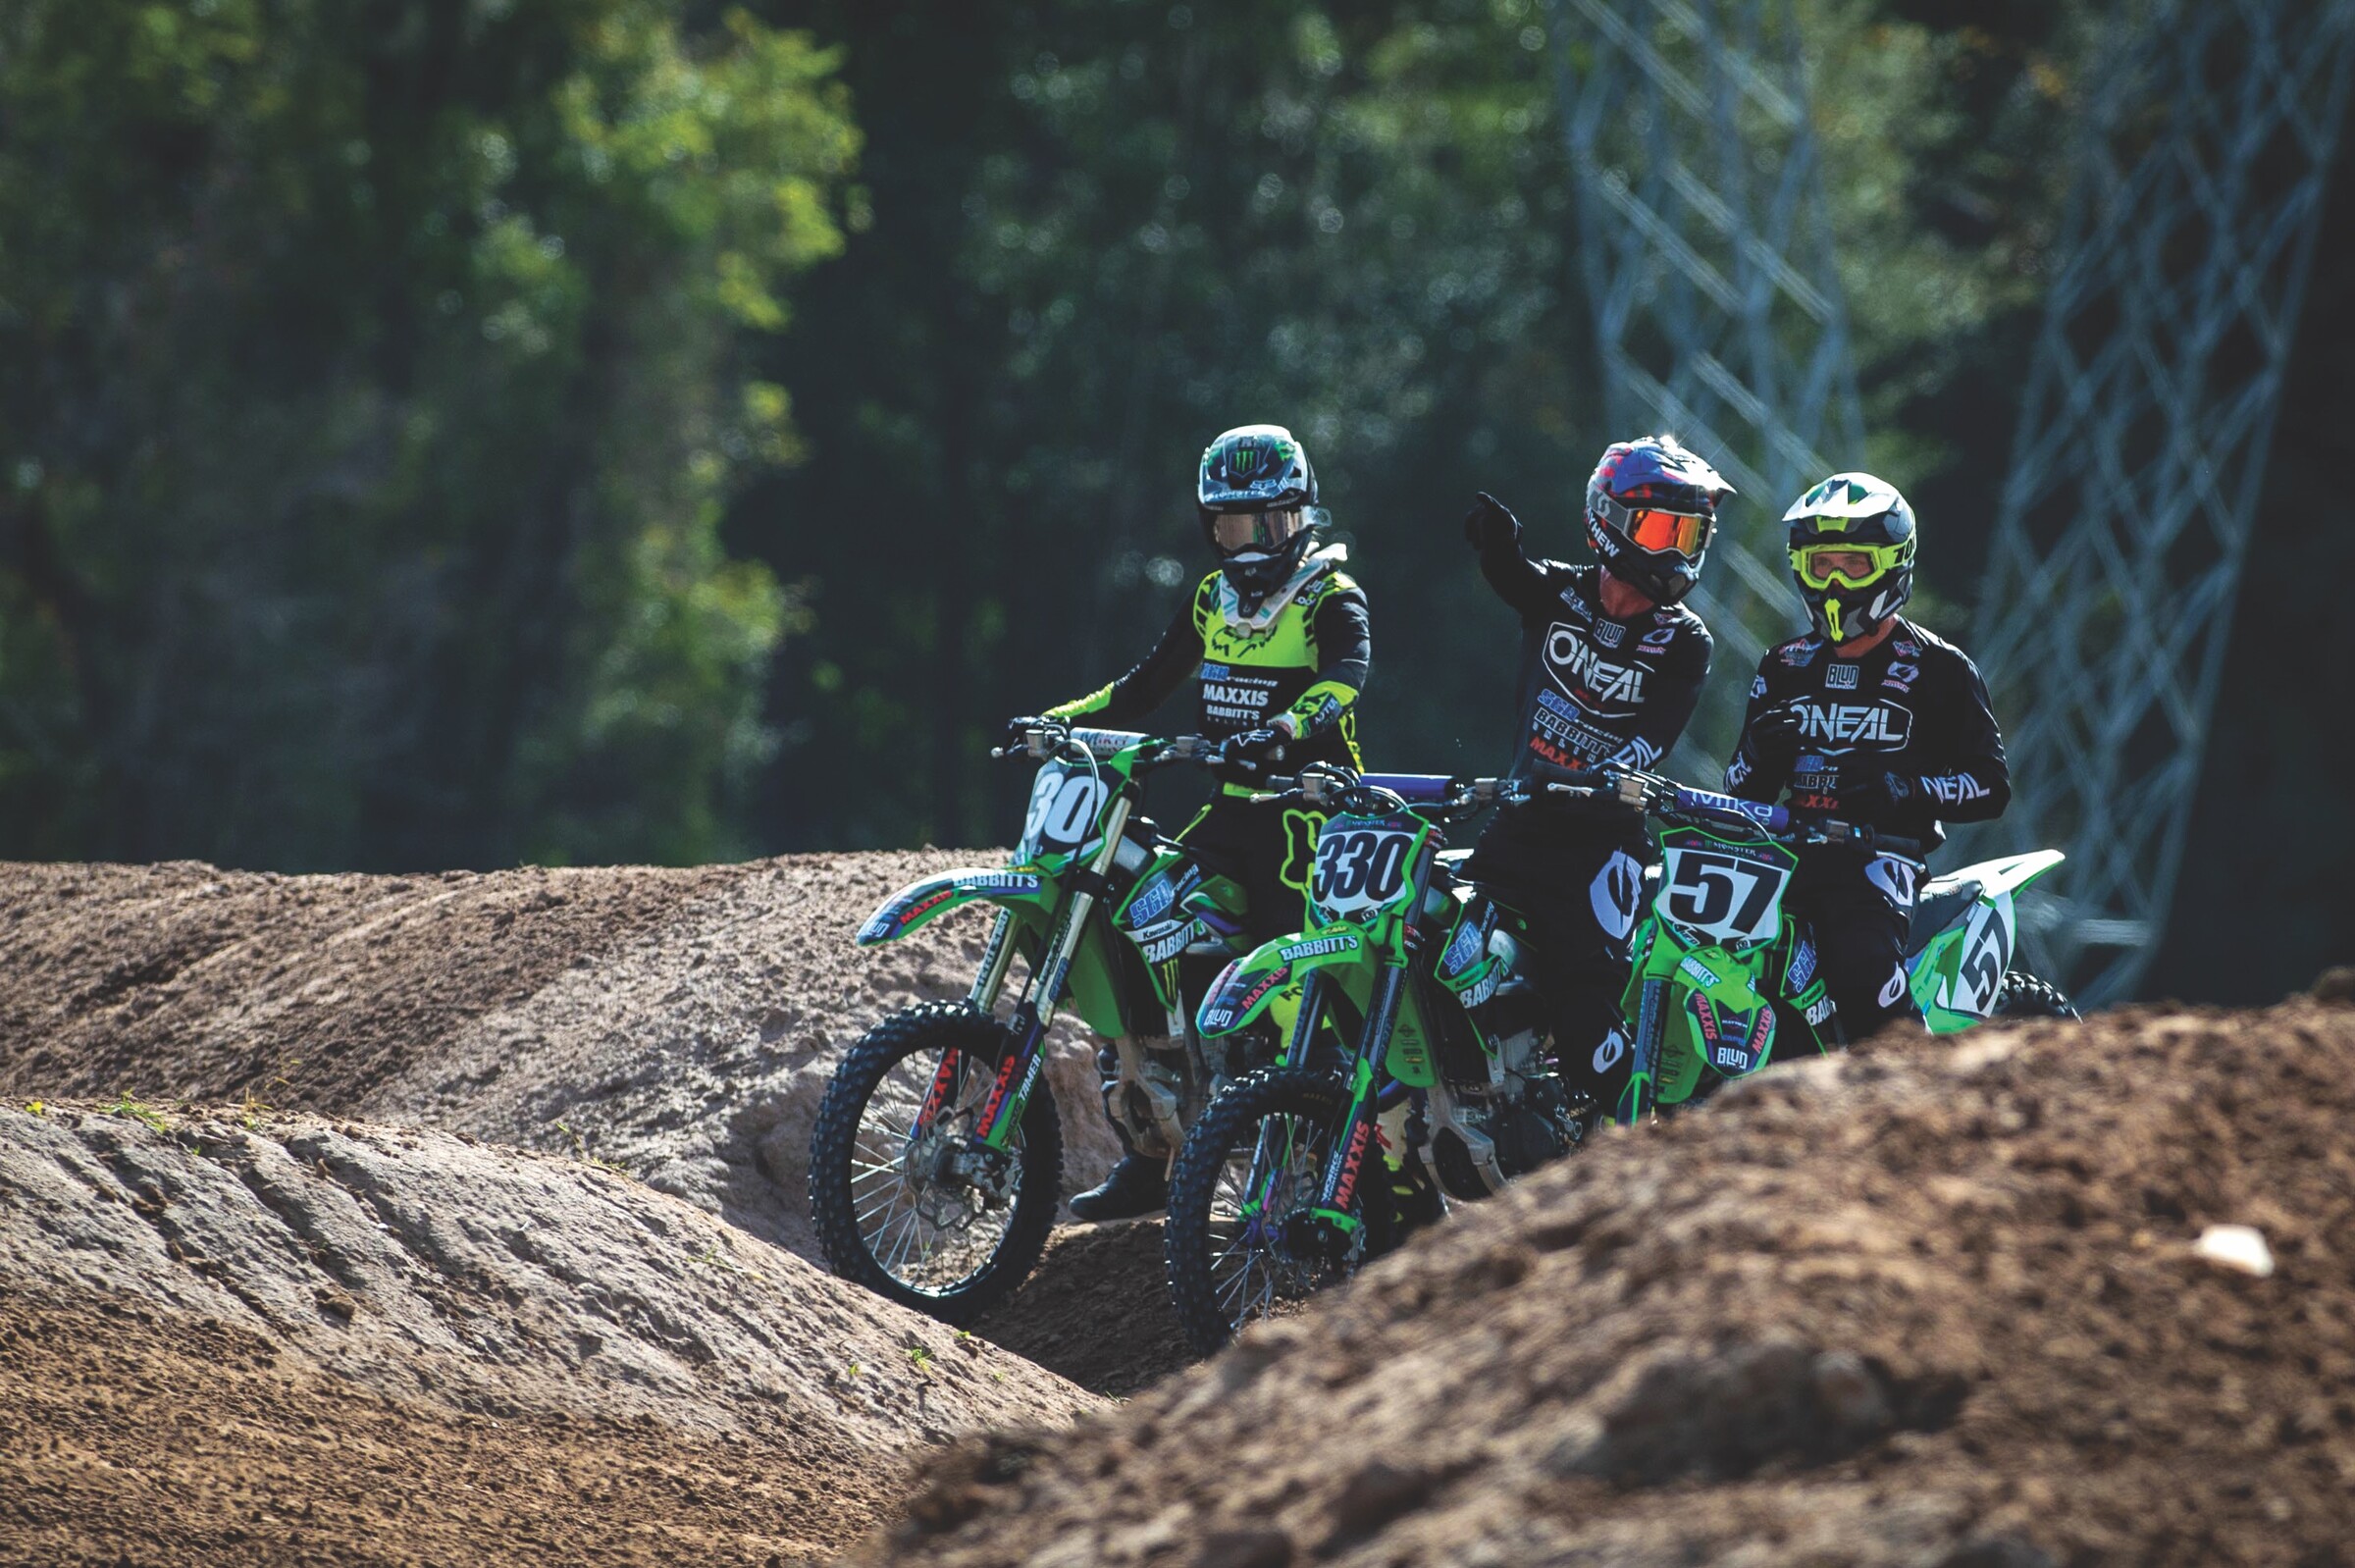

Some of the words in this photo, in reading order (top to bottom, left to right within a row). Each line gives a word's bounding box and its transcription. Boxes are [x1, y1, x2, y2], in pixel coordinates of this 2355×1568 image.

[1203, 684, 1269, 706] MAXXIS
[1827, 665, 1858, 687] BLUD
[1206, 705, 1260, 720] BABBITT'S
[1172, 863, 1199, 897] racing
[1312, 832, 1415, 902] 330
[1669, 851, 1783, 935] 57
[1280, 935, 1358, 962] BABBITT'S
[1241, 967, 1288, 1010] MAXXIS
[1203, 1008, 1233, 1027] BLUD
[1695, 993, 1717, 1040] MAXXIS
[1752, 1008, 1772, 1055] MAXXIS
[1018, 1053, 1042, 1101] TAMER
[1717, 1047, 1748, 1069] BLUD
[1334, 1120, 1370, 1210] MAXXIS
